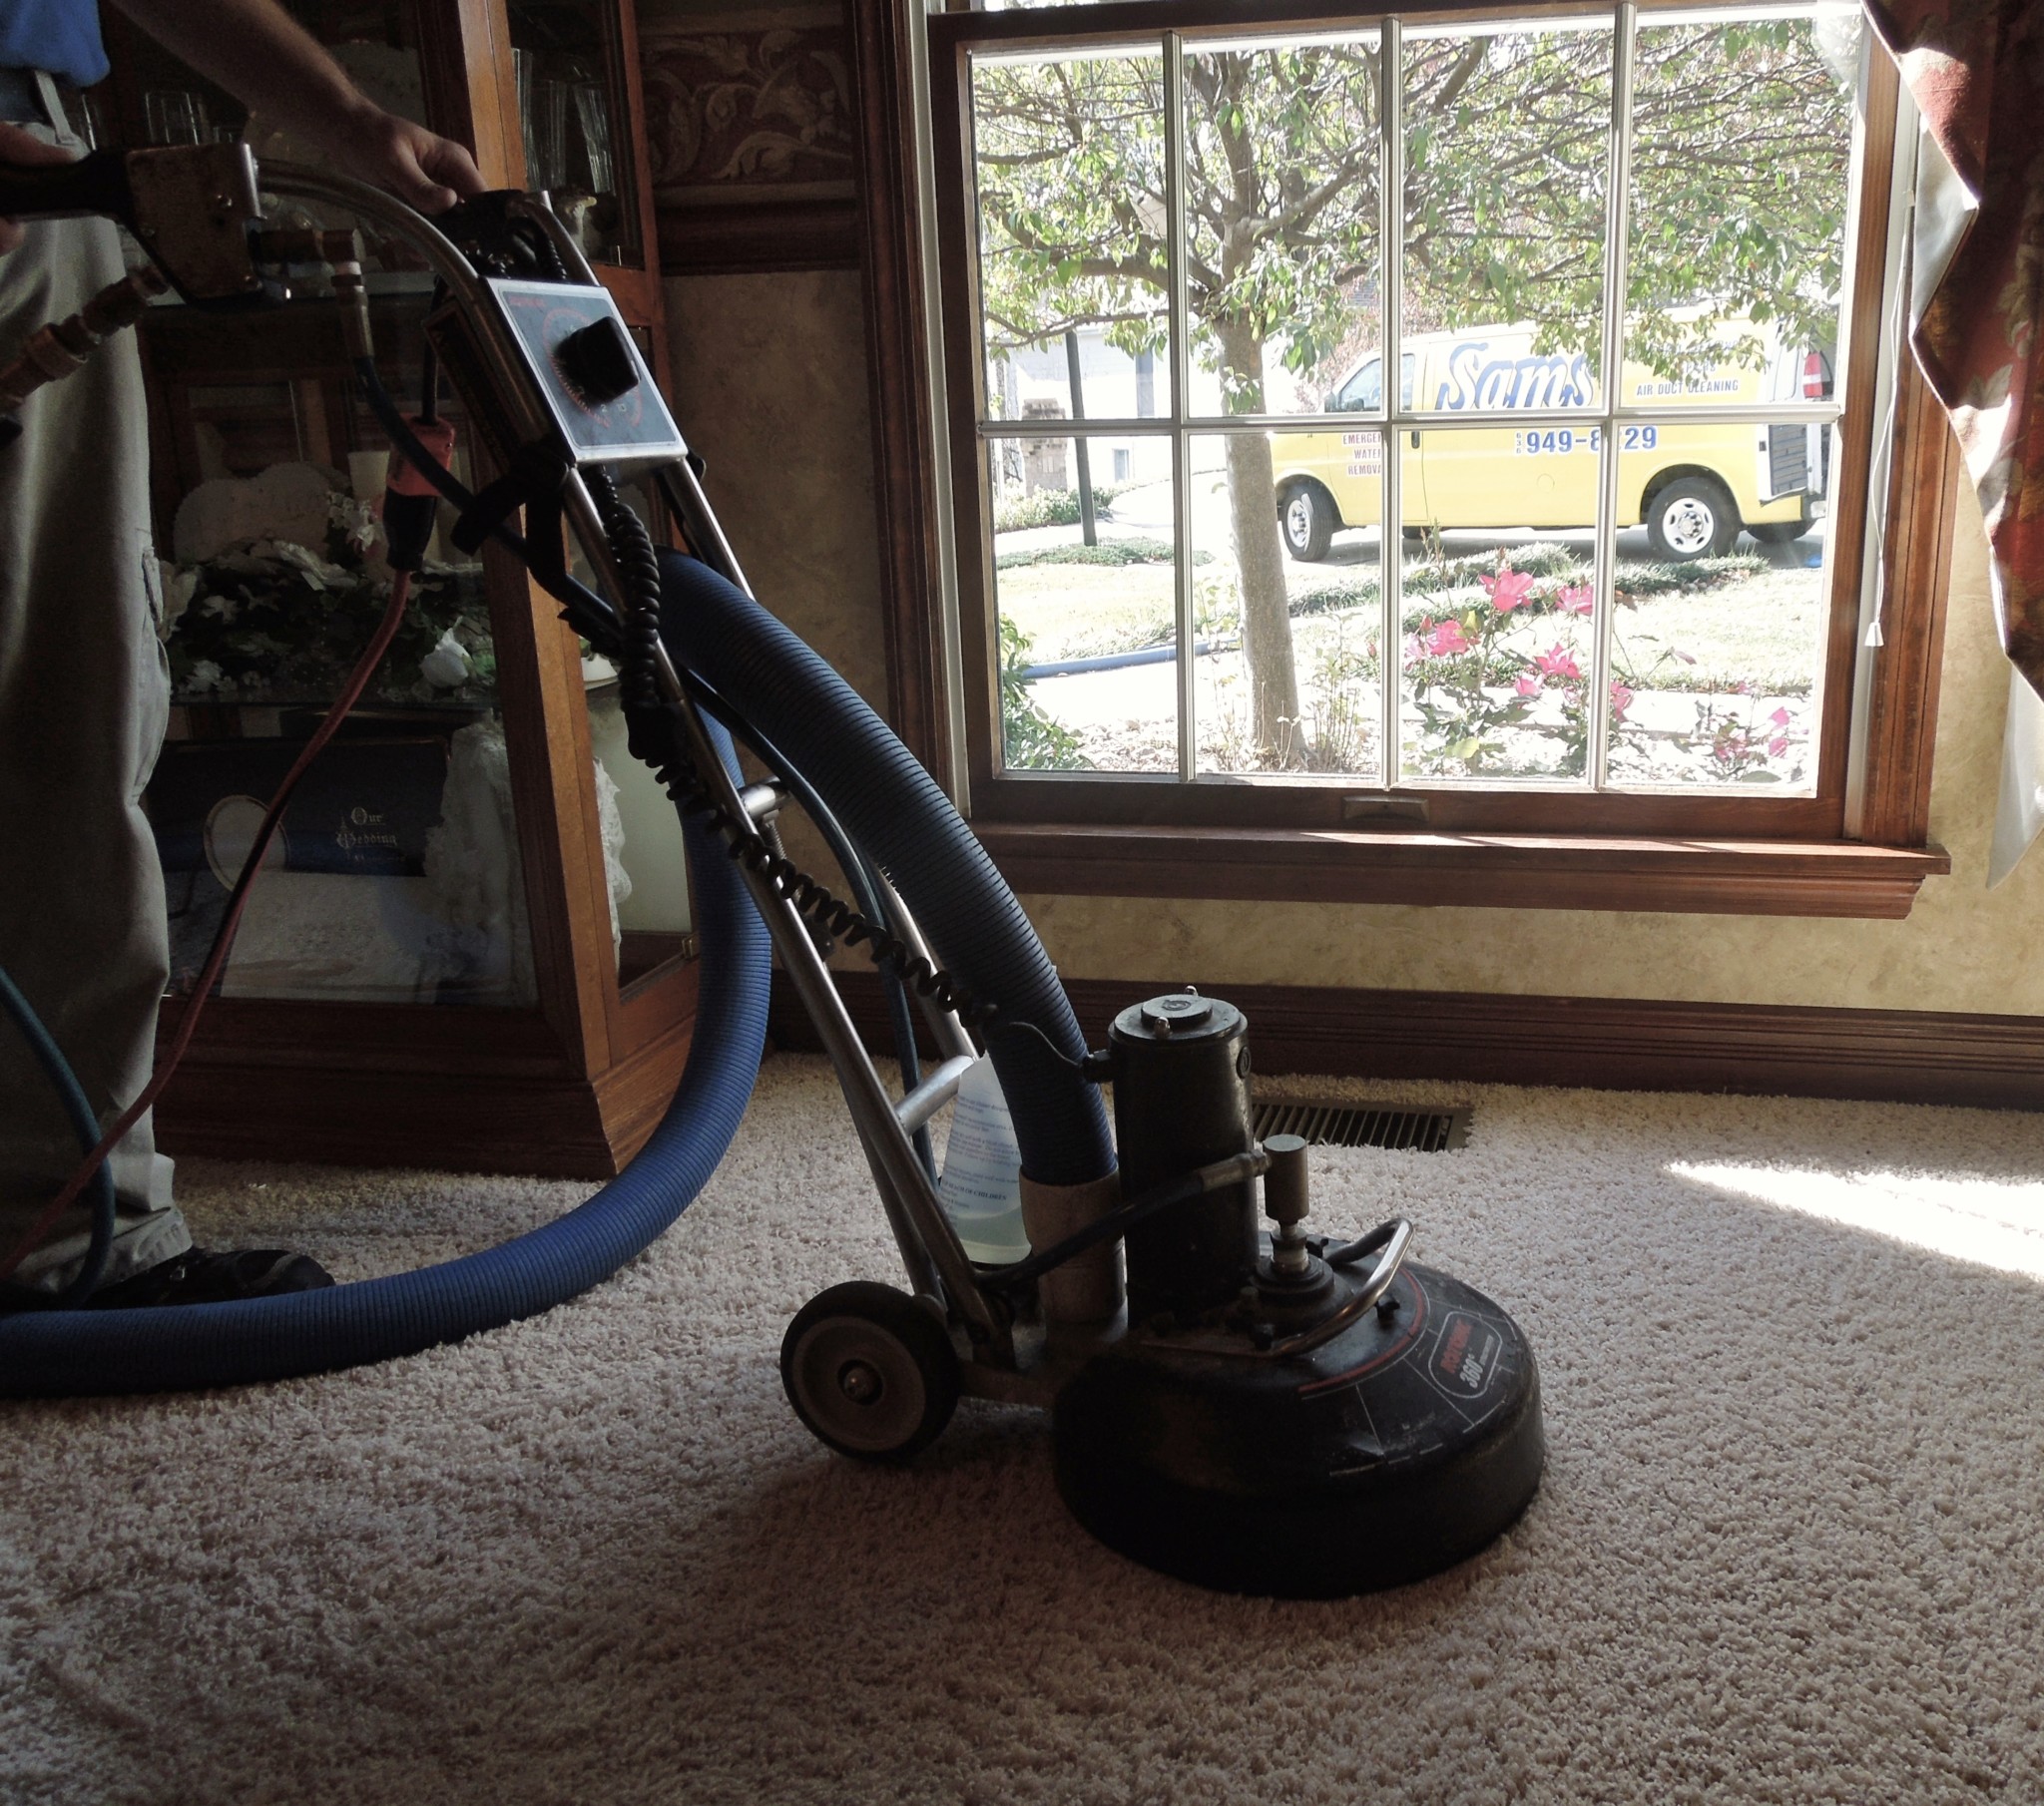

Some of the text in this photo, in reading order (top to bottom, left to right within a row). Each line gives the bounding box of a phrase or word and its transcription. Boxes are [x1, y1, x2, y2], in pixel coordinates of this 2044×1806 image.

[1435, 341, 1594, 410] Sams
[1636, 384, 1654, 396] AIR
[1658, 382, 1684, 395] DUCT
[1526, 425, 1657, 454] 949-829
[350, 806, 383, 825] Our
[335, 831, 397, 848] Wedding
